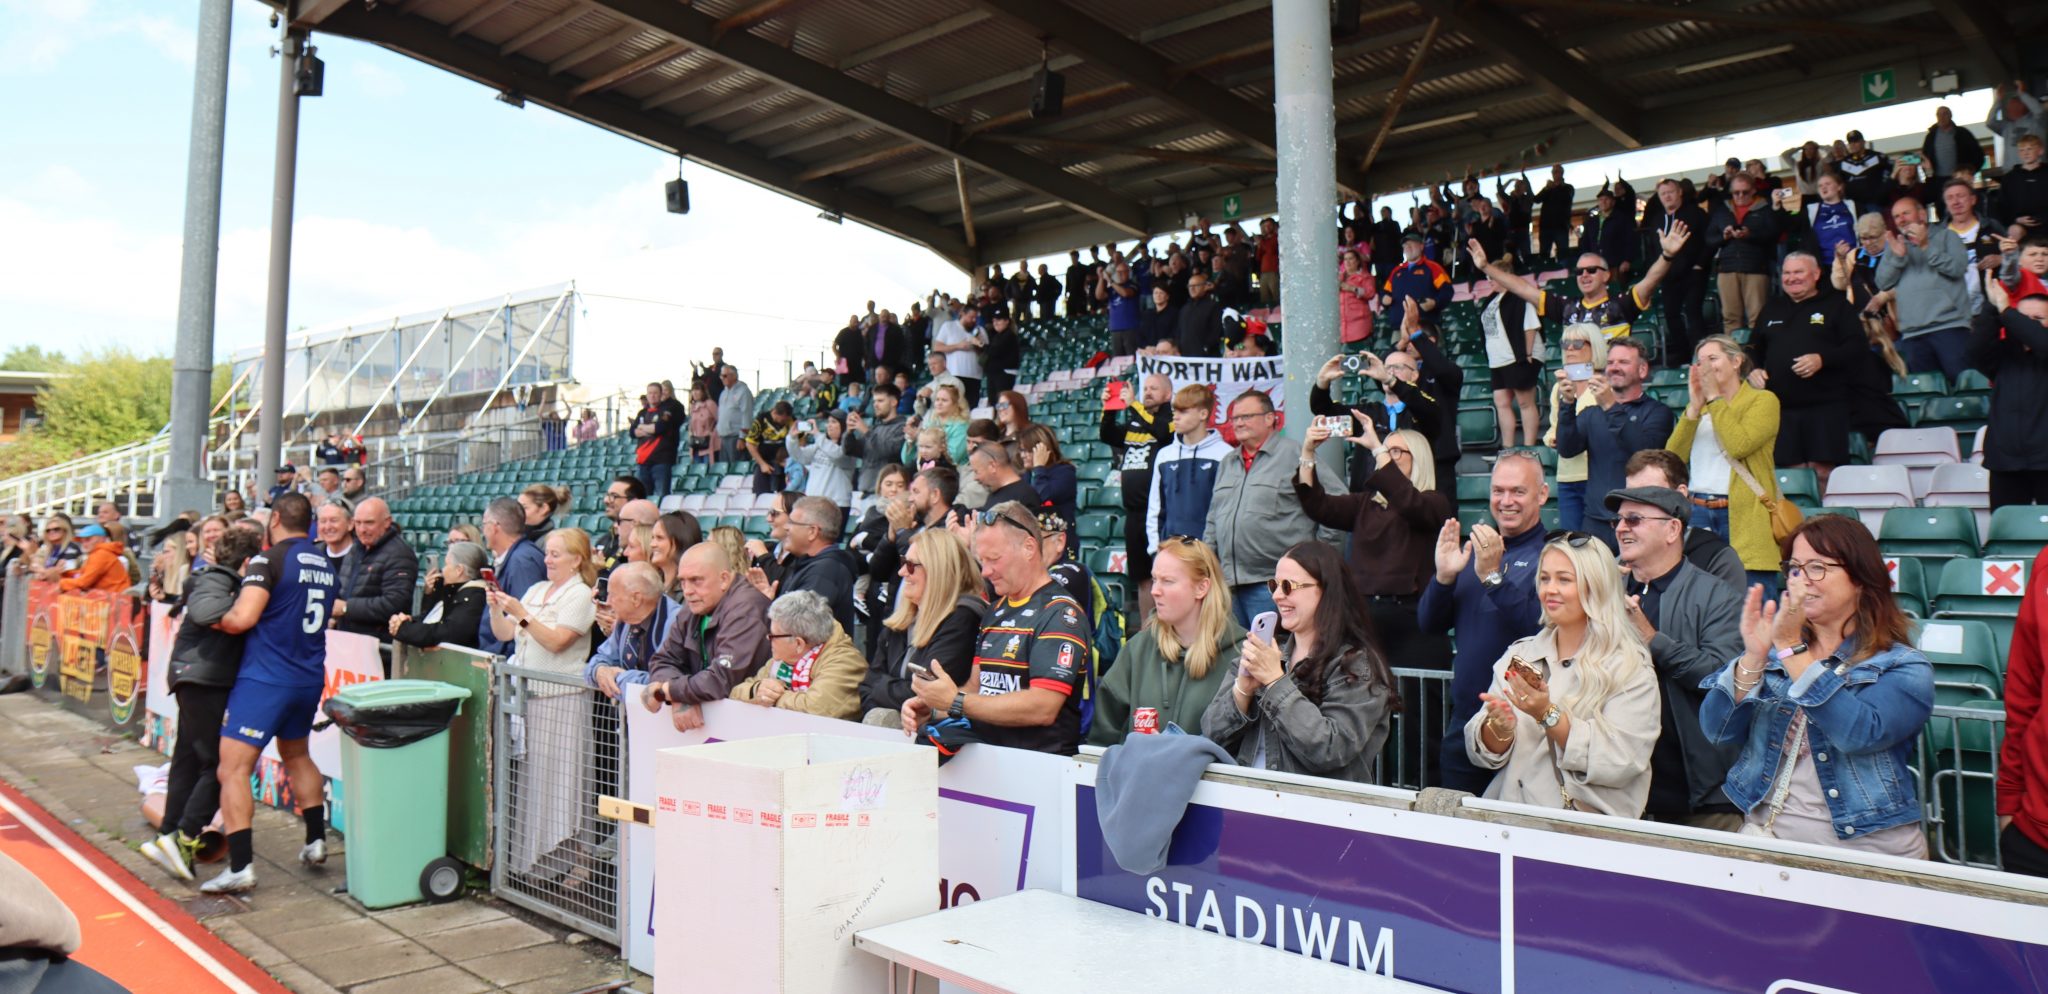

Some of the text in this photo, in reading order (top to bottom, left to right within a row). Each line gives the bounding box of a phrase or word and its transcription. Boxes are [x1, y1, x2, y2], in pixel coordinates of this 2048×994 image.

[1141, 356, 1222, 382] NORTH
[312, 570, 334, 587] VAN
[303, 589, 325, 634] 5
[659, 796, 676, 807] FRAGILE
[708, 803, 726, 815] FRAGILE
[760, 811, 781, 823] FRAGILE
[825, 813, 849, 821] FRAGILE
[1145, 876, 1394, 978] STADIWM
